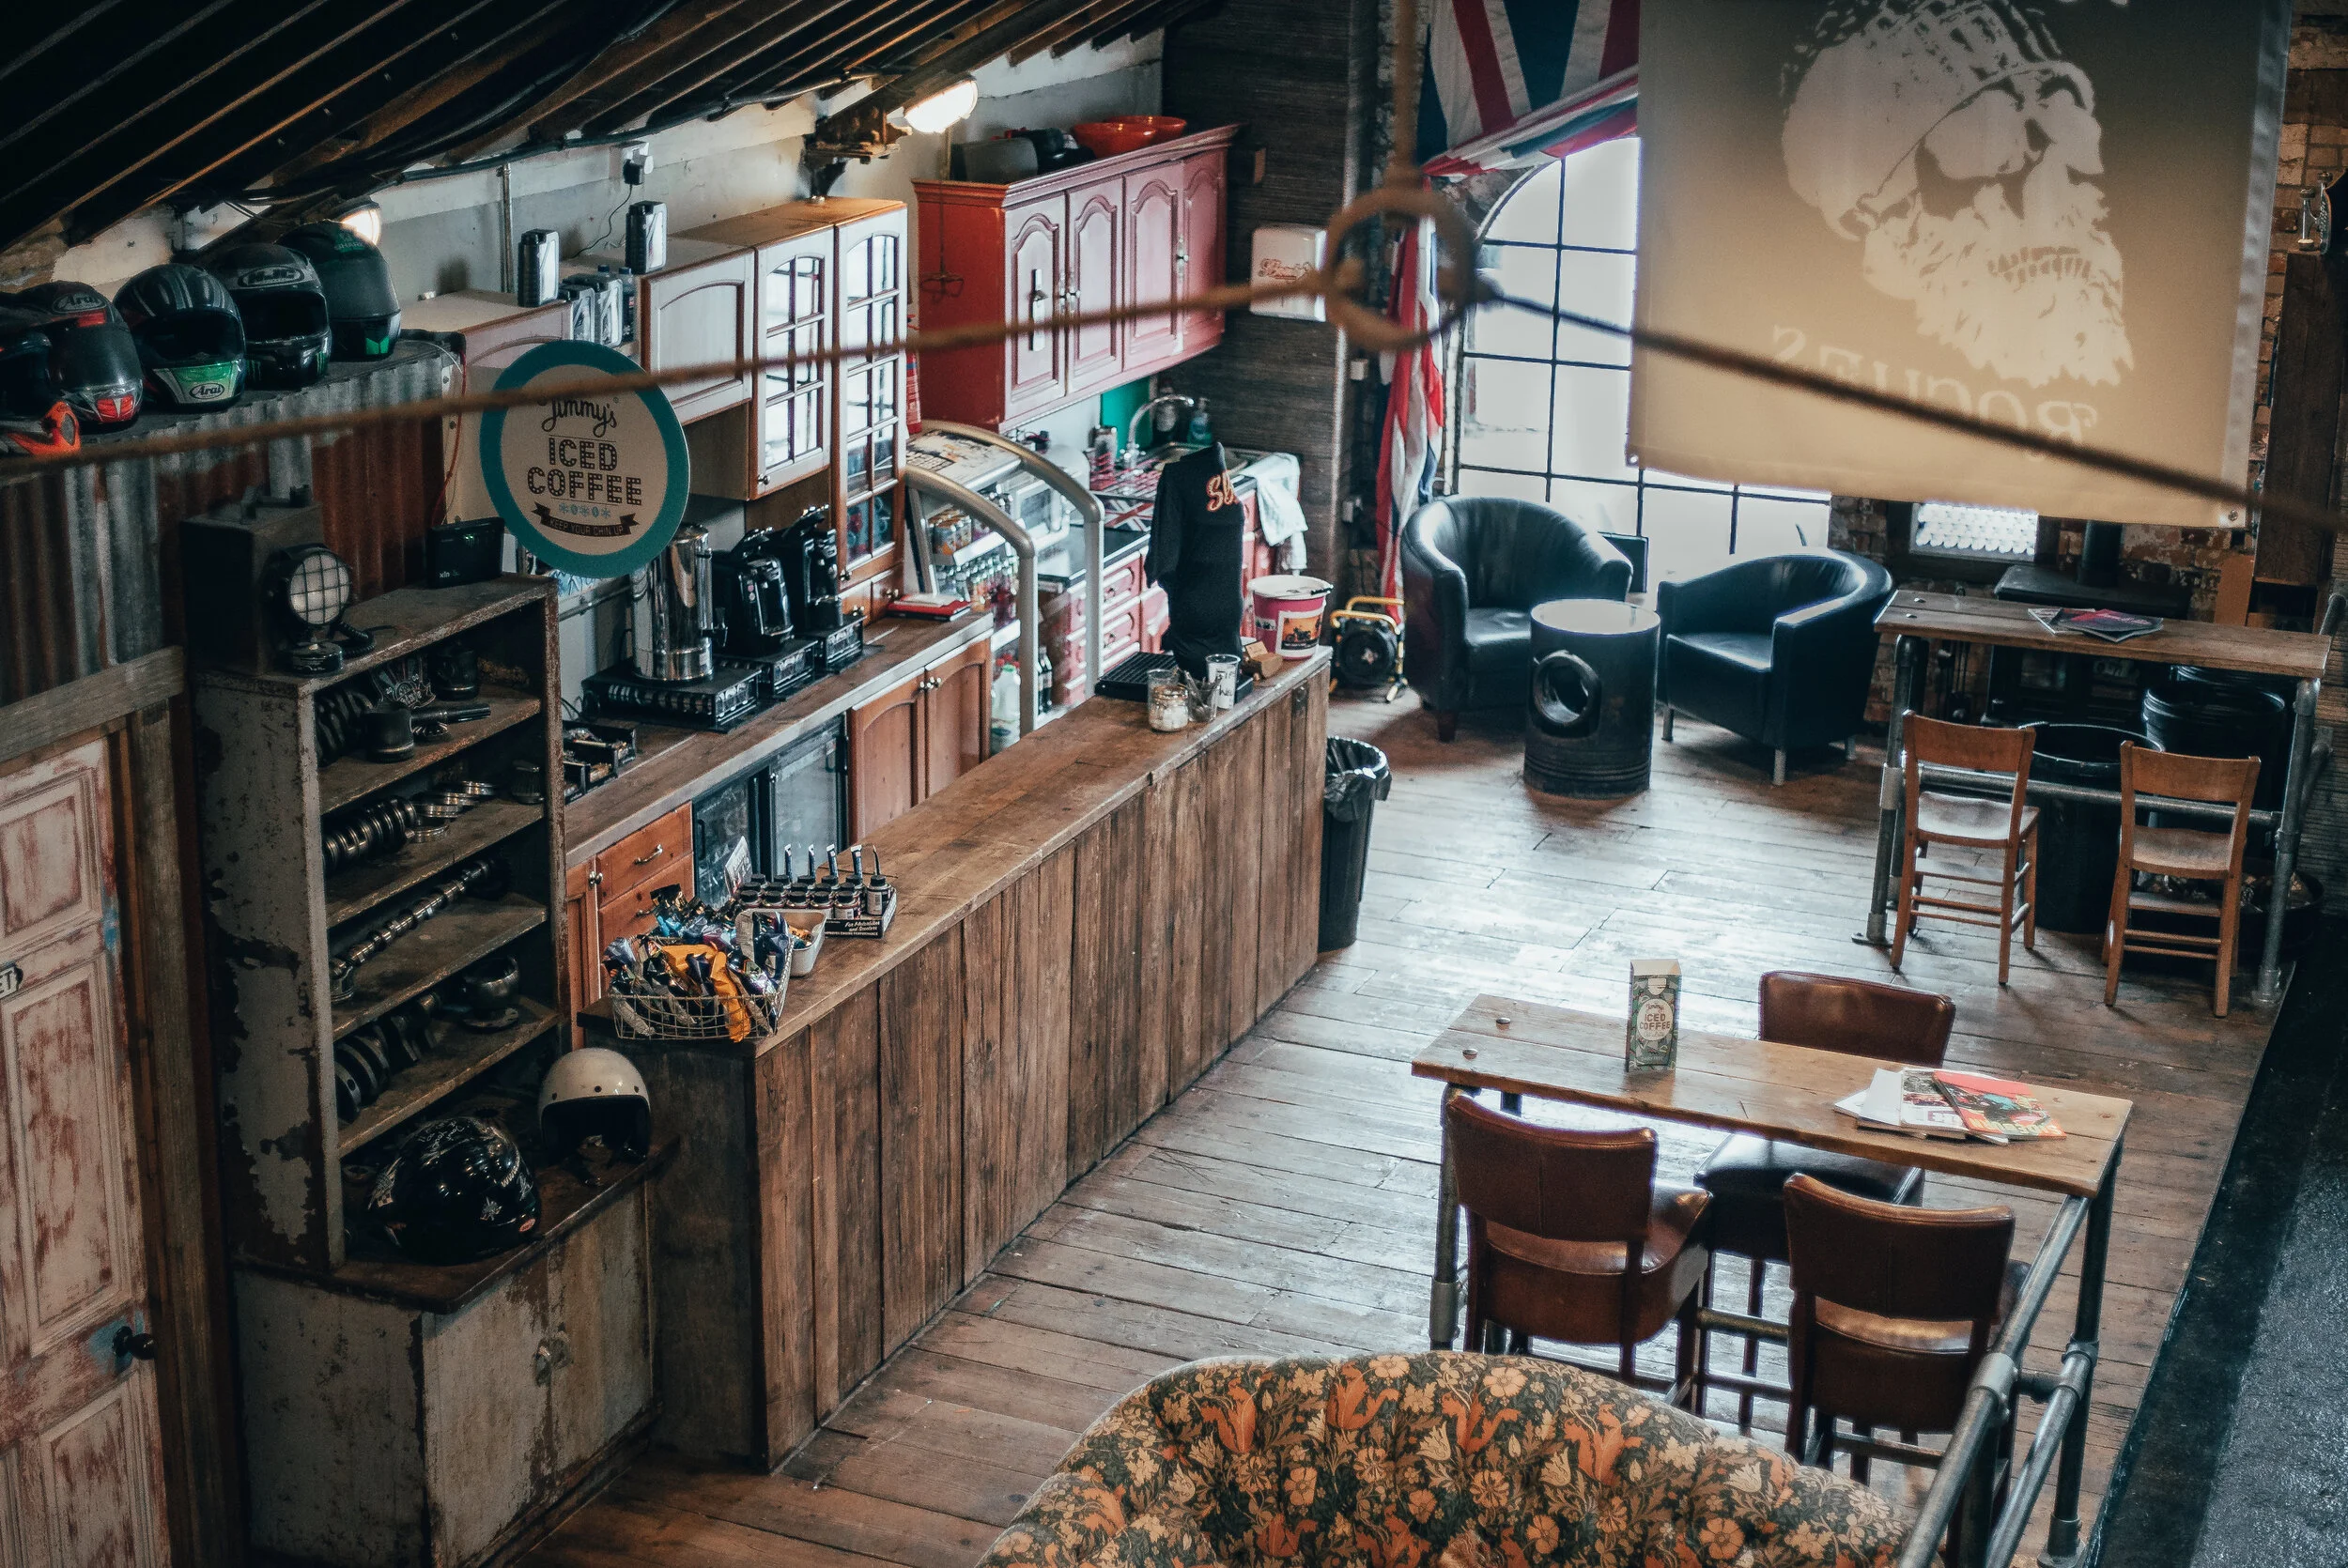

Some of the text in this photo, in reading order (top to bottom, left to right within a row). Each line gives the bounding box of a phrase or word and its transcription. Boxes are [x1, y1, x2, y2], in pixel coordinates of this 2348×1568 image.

[194, 384, 223, 396] Arai
[548, 438, 617, 471] ICED
[527, 467, 641, 506] COFFEE
[549, 518, 624, 536] KEEP YOUR CHIN UP
[1640, 1022, 1671, 1030] COFFEE
